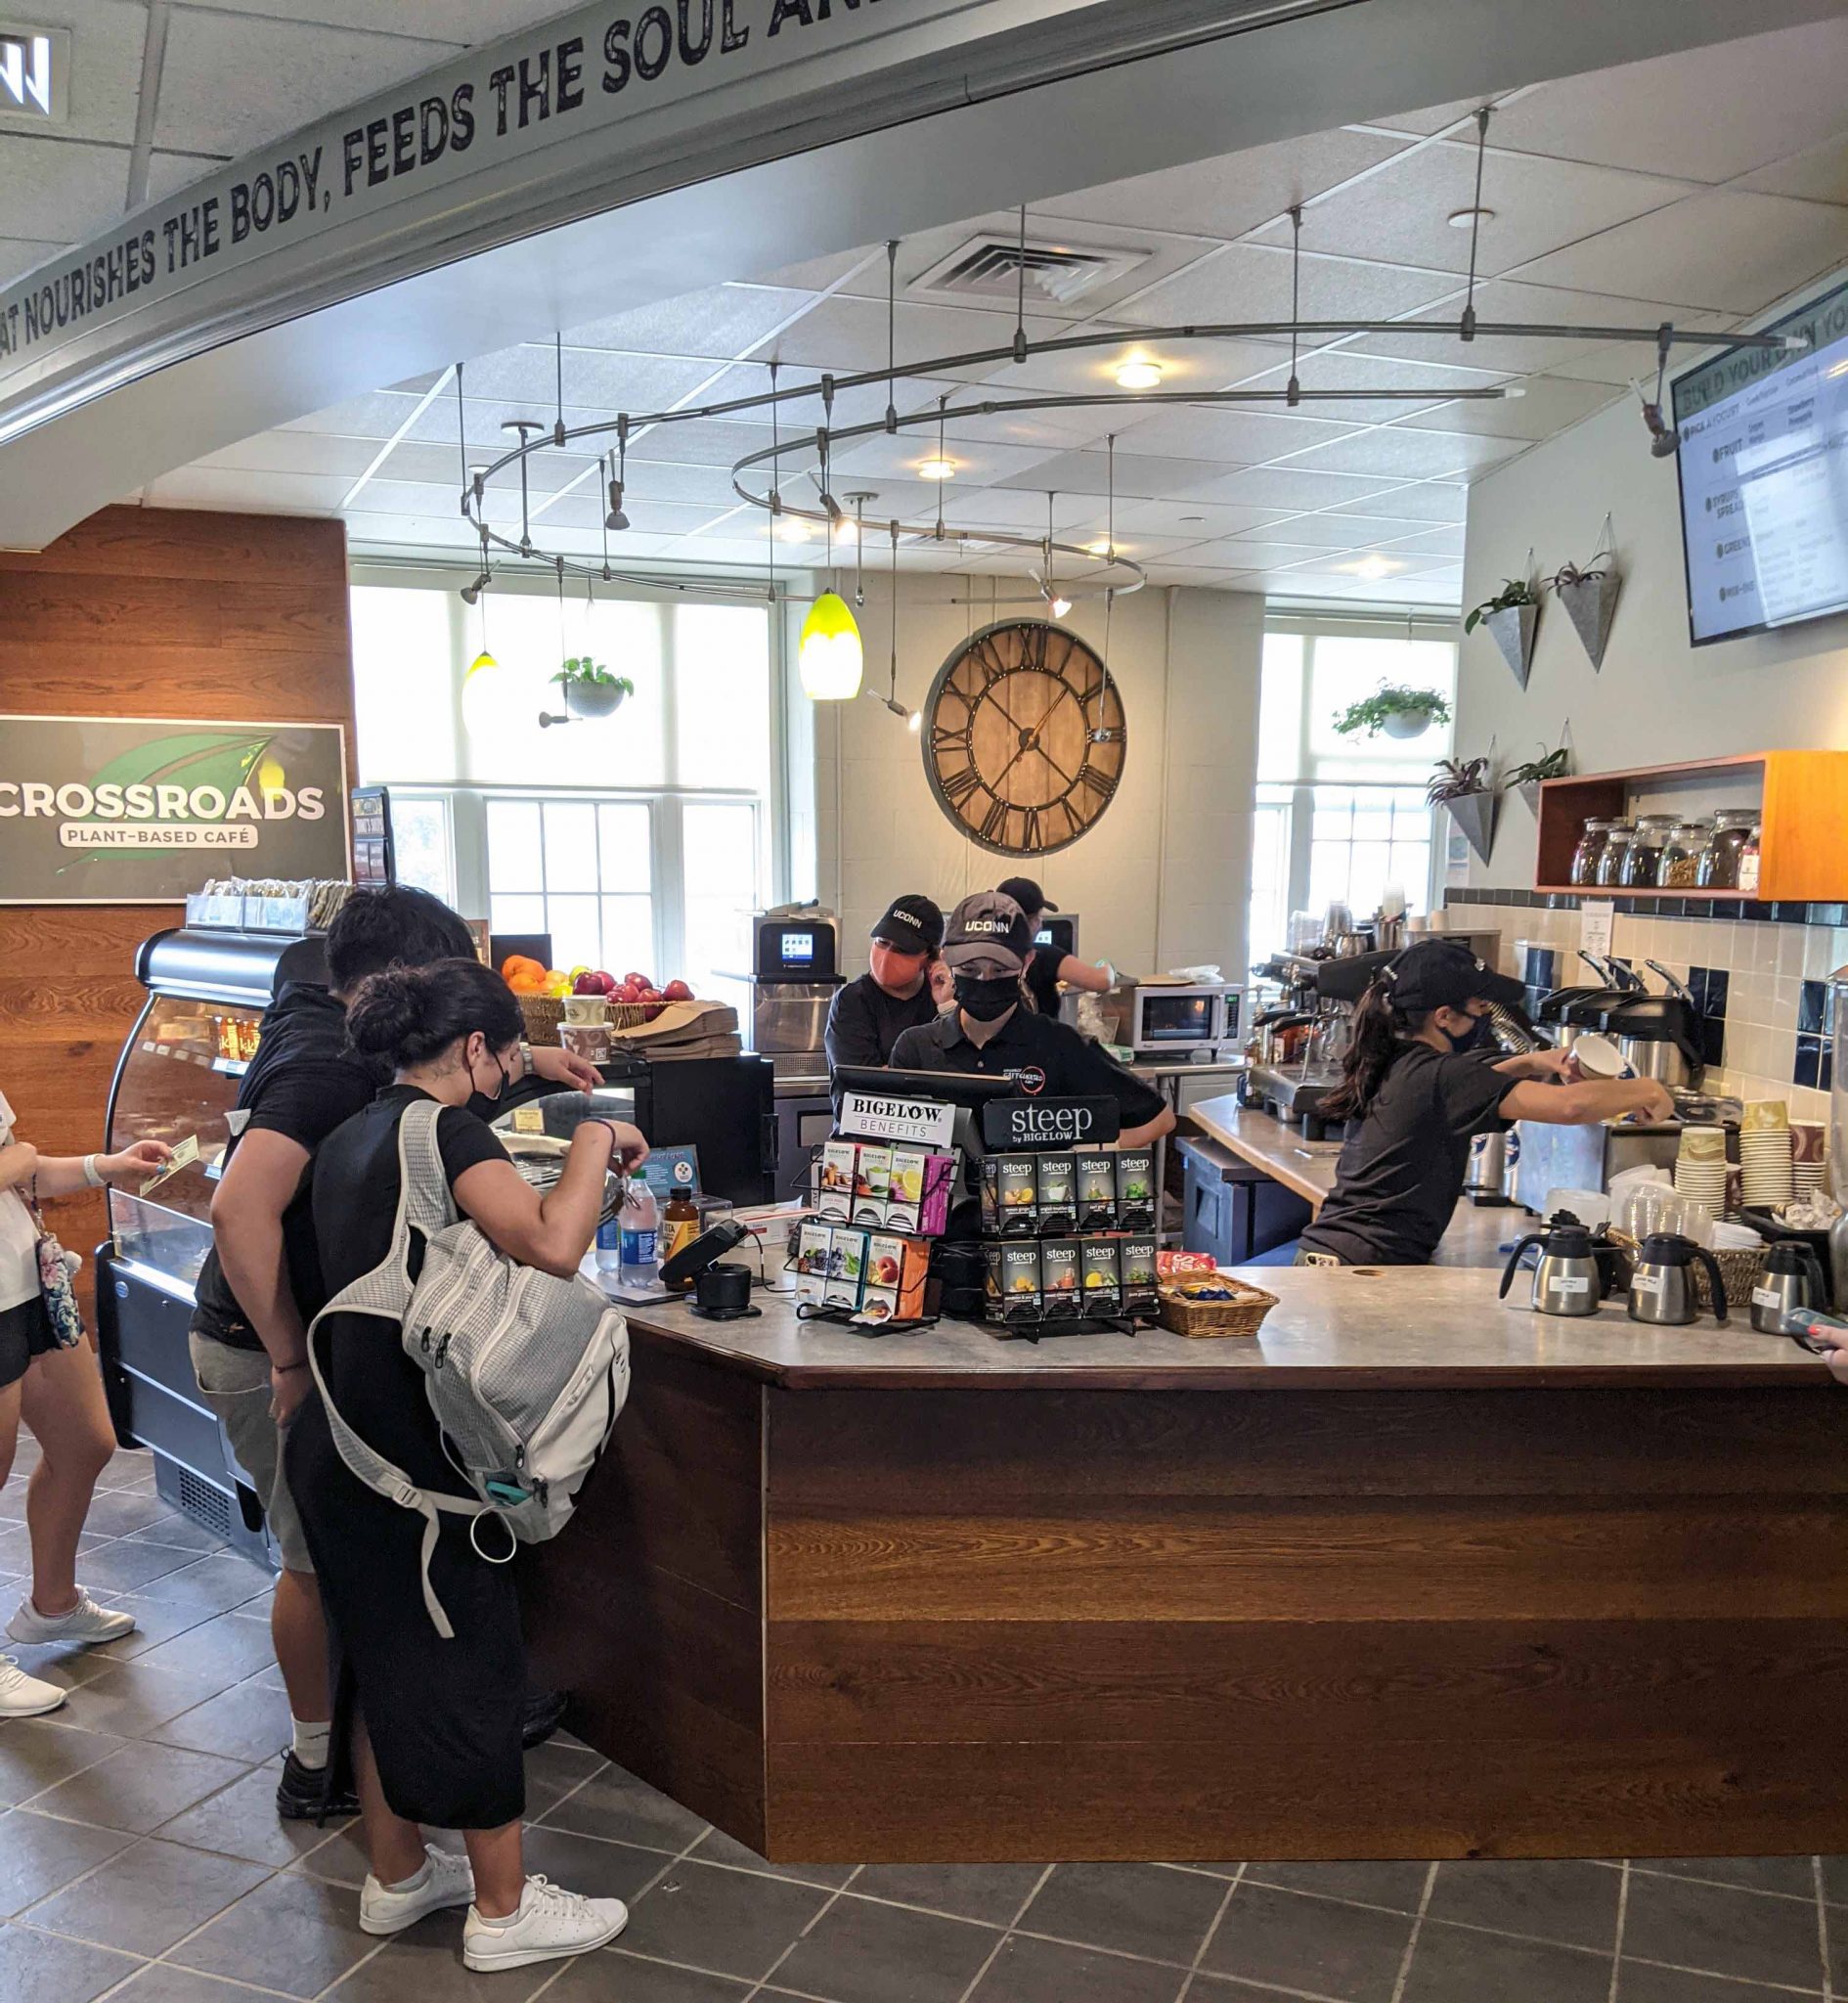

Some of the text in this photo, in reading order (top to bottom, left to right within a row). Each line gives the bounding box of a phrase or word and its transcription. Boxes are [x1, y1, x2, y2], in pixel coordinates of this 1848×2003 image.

[24, 230, 155, 345] NOURISHES
[164, 198, 221, 274] THE
[231, 146, 330, 244] BODY,
[343, 83, 476, 196] FEEDS
[490, 36, 585, 137] THE
[602, 0, 750, 94] SOUL
[1730, 349, 1772, 382] YOUR
[0, 782, 326, 821] CROSSROADS
[67, 827, 249, 844] PLANT-BASED CAFÉ
[893, 909, 924, 929] UCONN
[965, 920, 1009, 934] UCONN
[852, 1098, 944, 1122] BIGELOW
[860, 1119, 927, 1137] BENEFITS
[1011, 1103, 1093, 1140] steep
[1012, 1132, 1073, 1143] by BIGELOW
[1002, 1162, 1033, 1177] steep
[1042, 1161, 1072, 1174] steep
[1081, 1159, 1111, 1173] steep
[1121, 1158, 1150, 1171] steep
[1007, 1251, 1036, 1265] steep
[1046, 1249, 1076, 1262] steep
[1086, 1247, 1116, 1261] steep
[1125, 1245, 1154, 1258] steep
